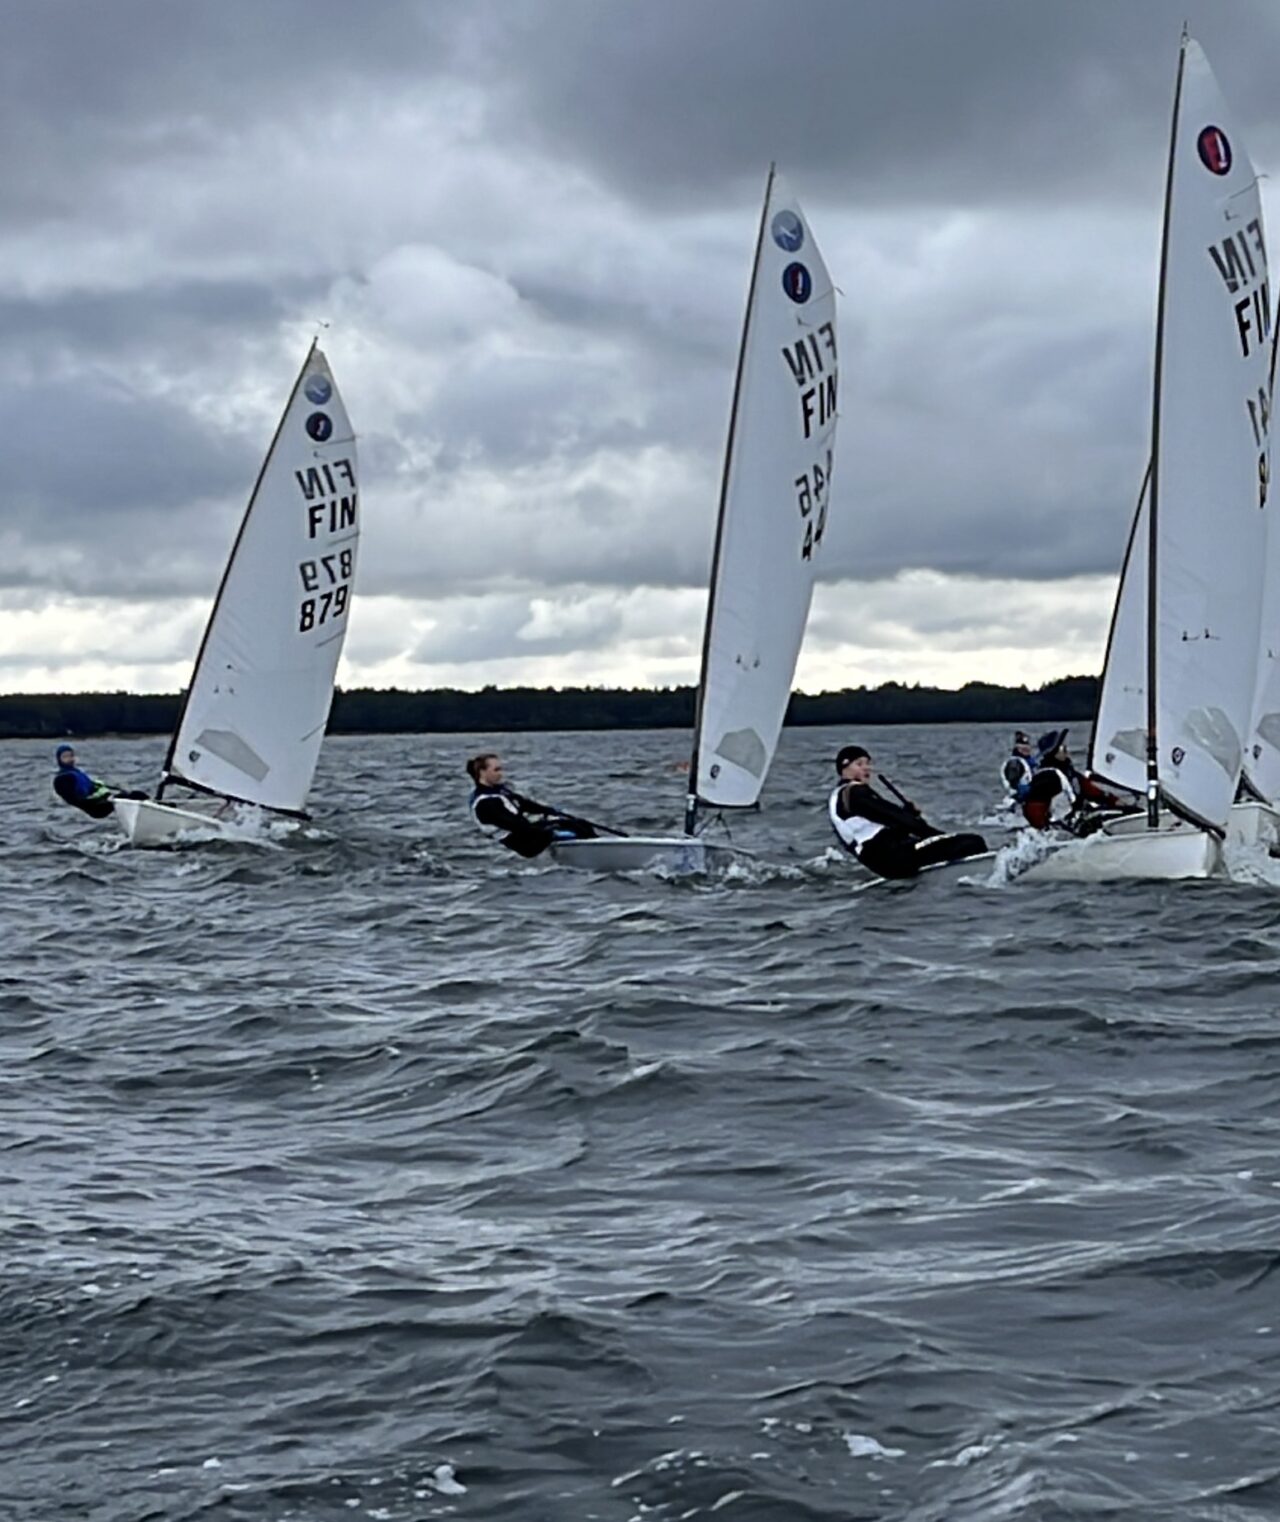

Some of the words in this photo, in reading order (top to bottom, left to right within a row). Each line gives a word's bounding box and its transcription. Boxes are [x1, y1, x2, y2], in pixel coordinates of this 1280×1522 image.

[802, 370, 837, 439] FIN
[308, 494, 357, 539] FIN
[299, 584, 348, 632] 879
